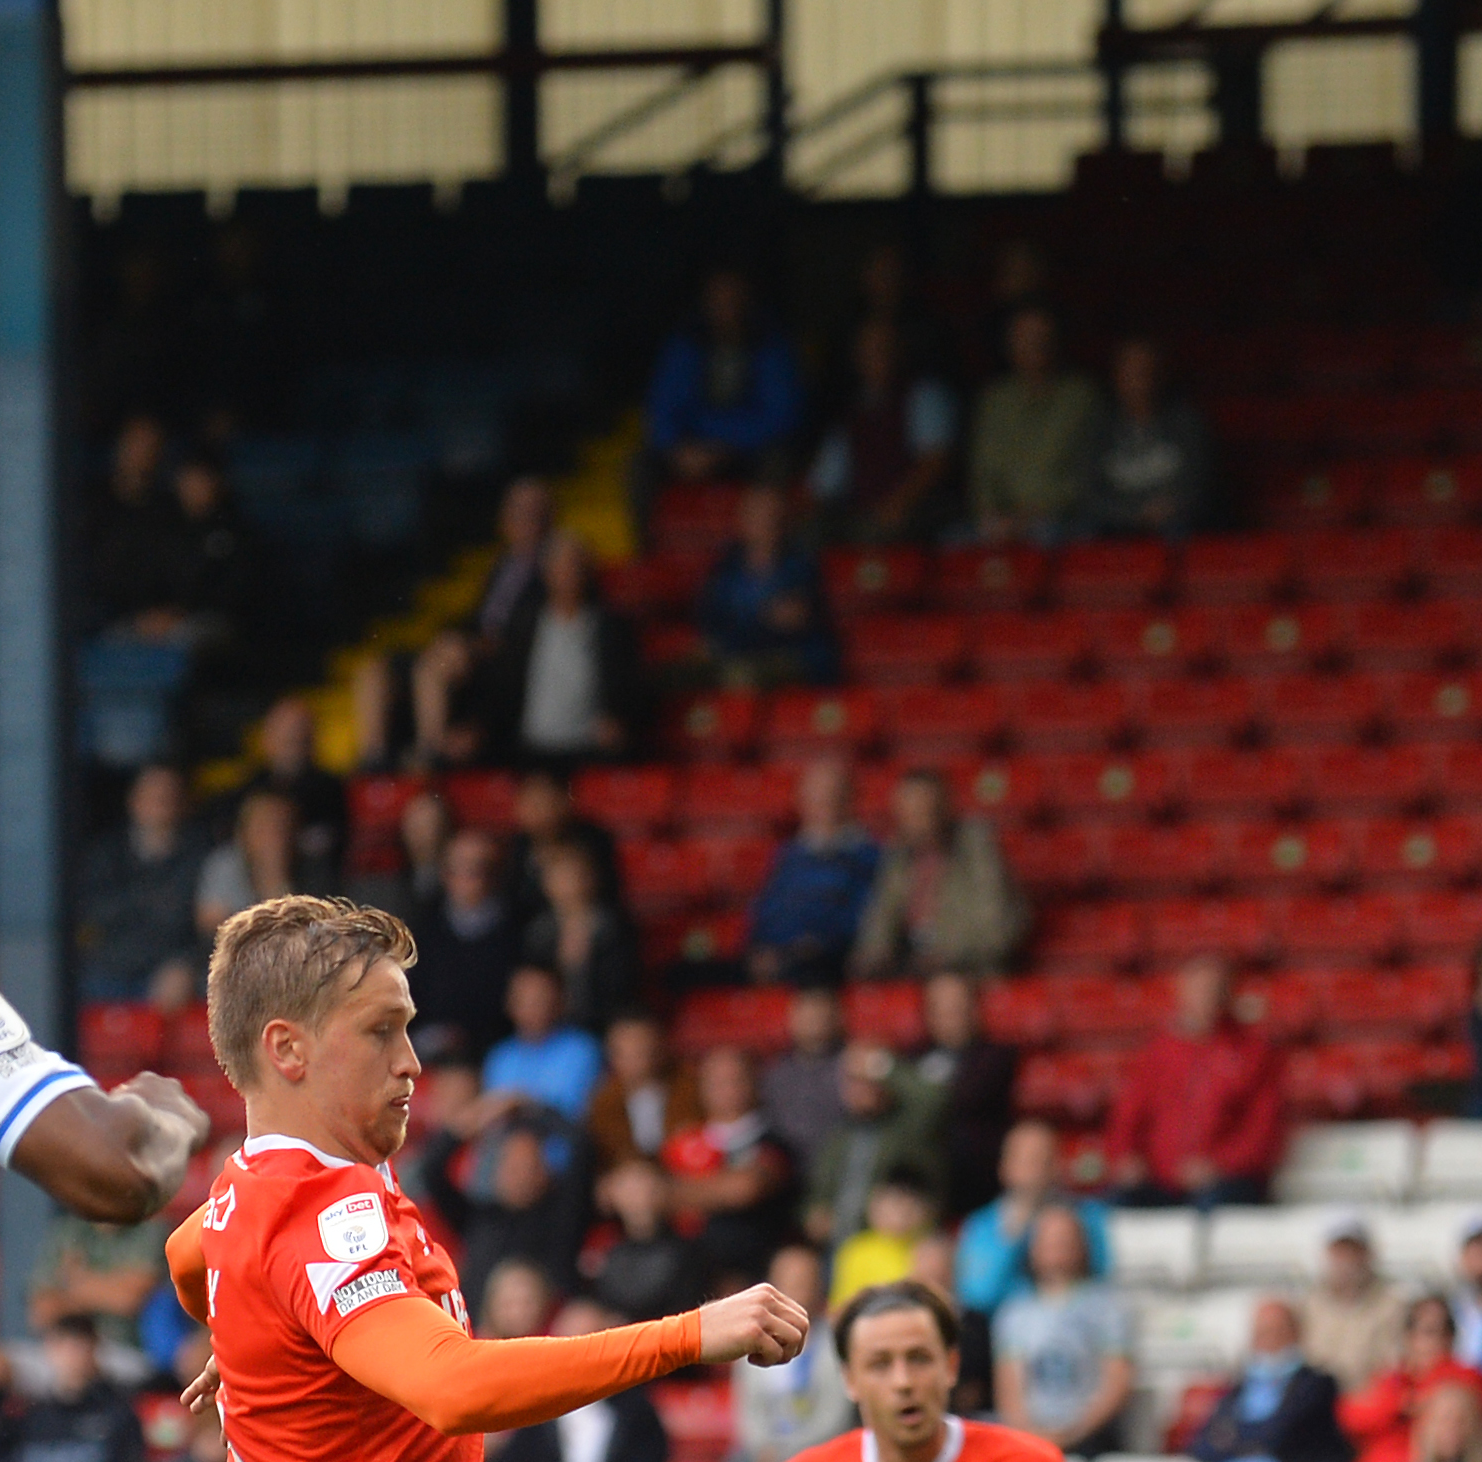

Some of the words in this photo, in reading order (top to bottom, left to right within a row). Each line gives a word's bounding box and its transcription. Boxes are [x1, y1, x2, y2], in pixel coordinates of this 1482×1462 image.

[324, 1208, 344, 1222] sky
[347, 1200, 373, 1213] bet
[349, 1245, 369, 1254] EFL
[332, 1281, 358, 1305] NOT
[357, 1269, 399, 1288] TODAY
[339, 1298, 356, 1313] OR
[357, 1286, 381, 1303] ANY
[382, 1280, 404, 1293] DAY
